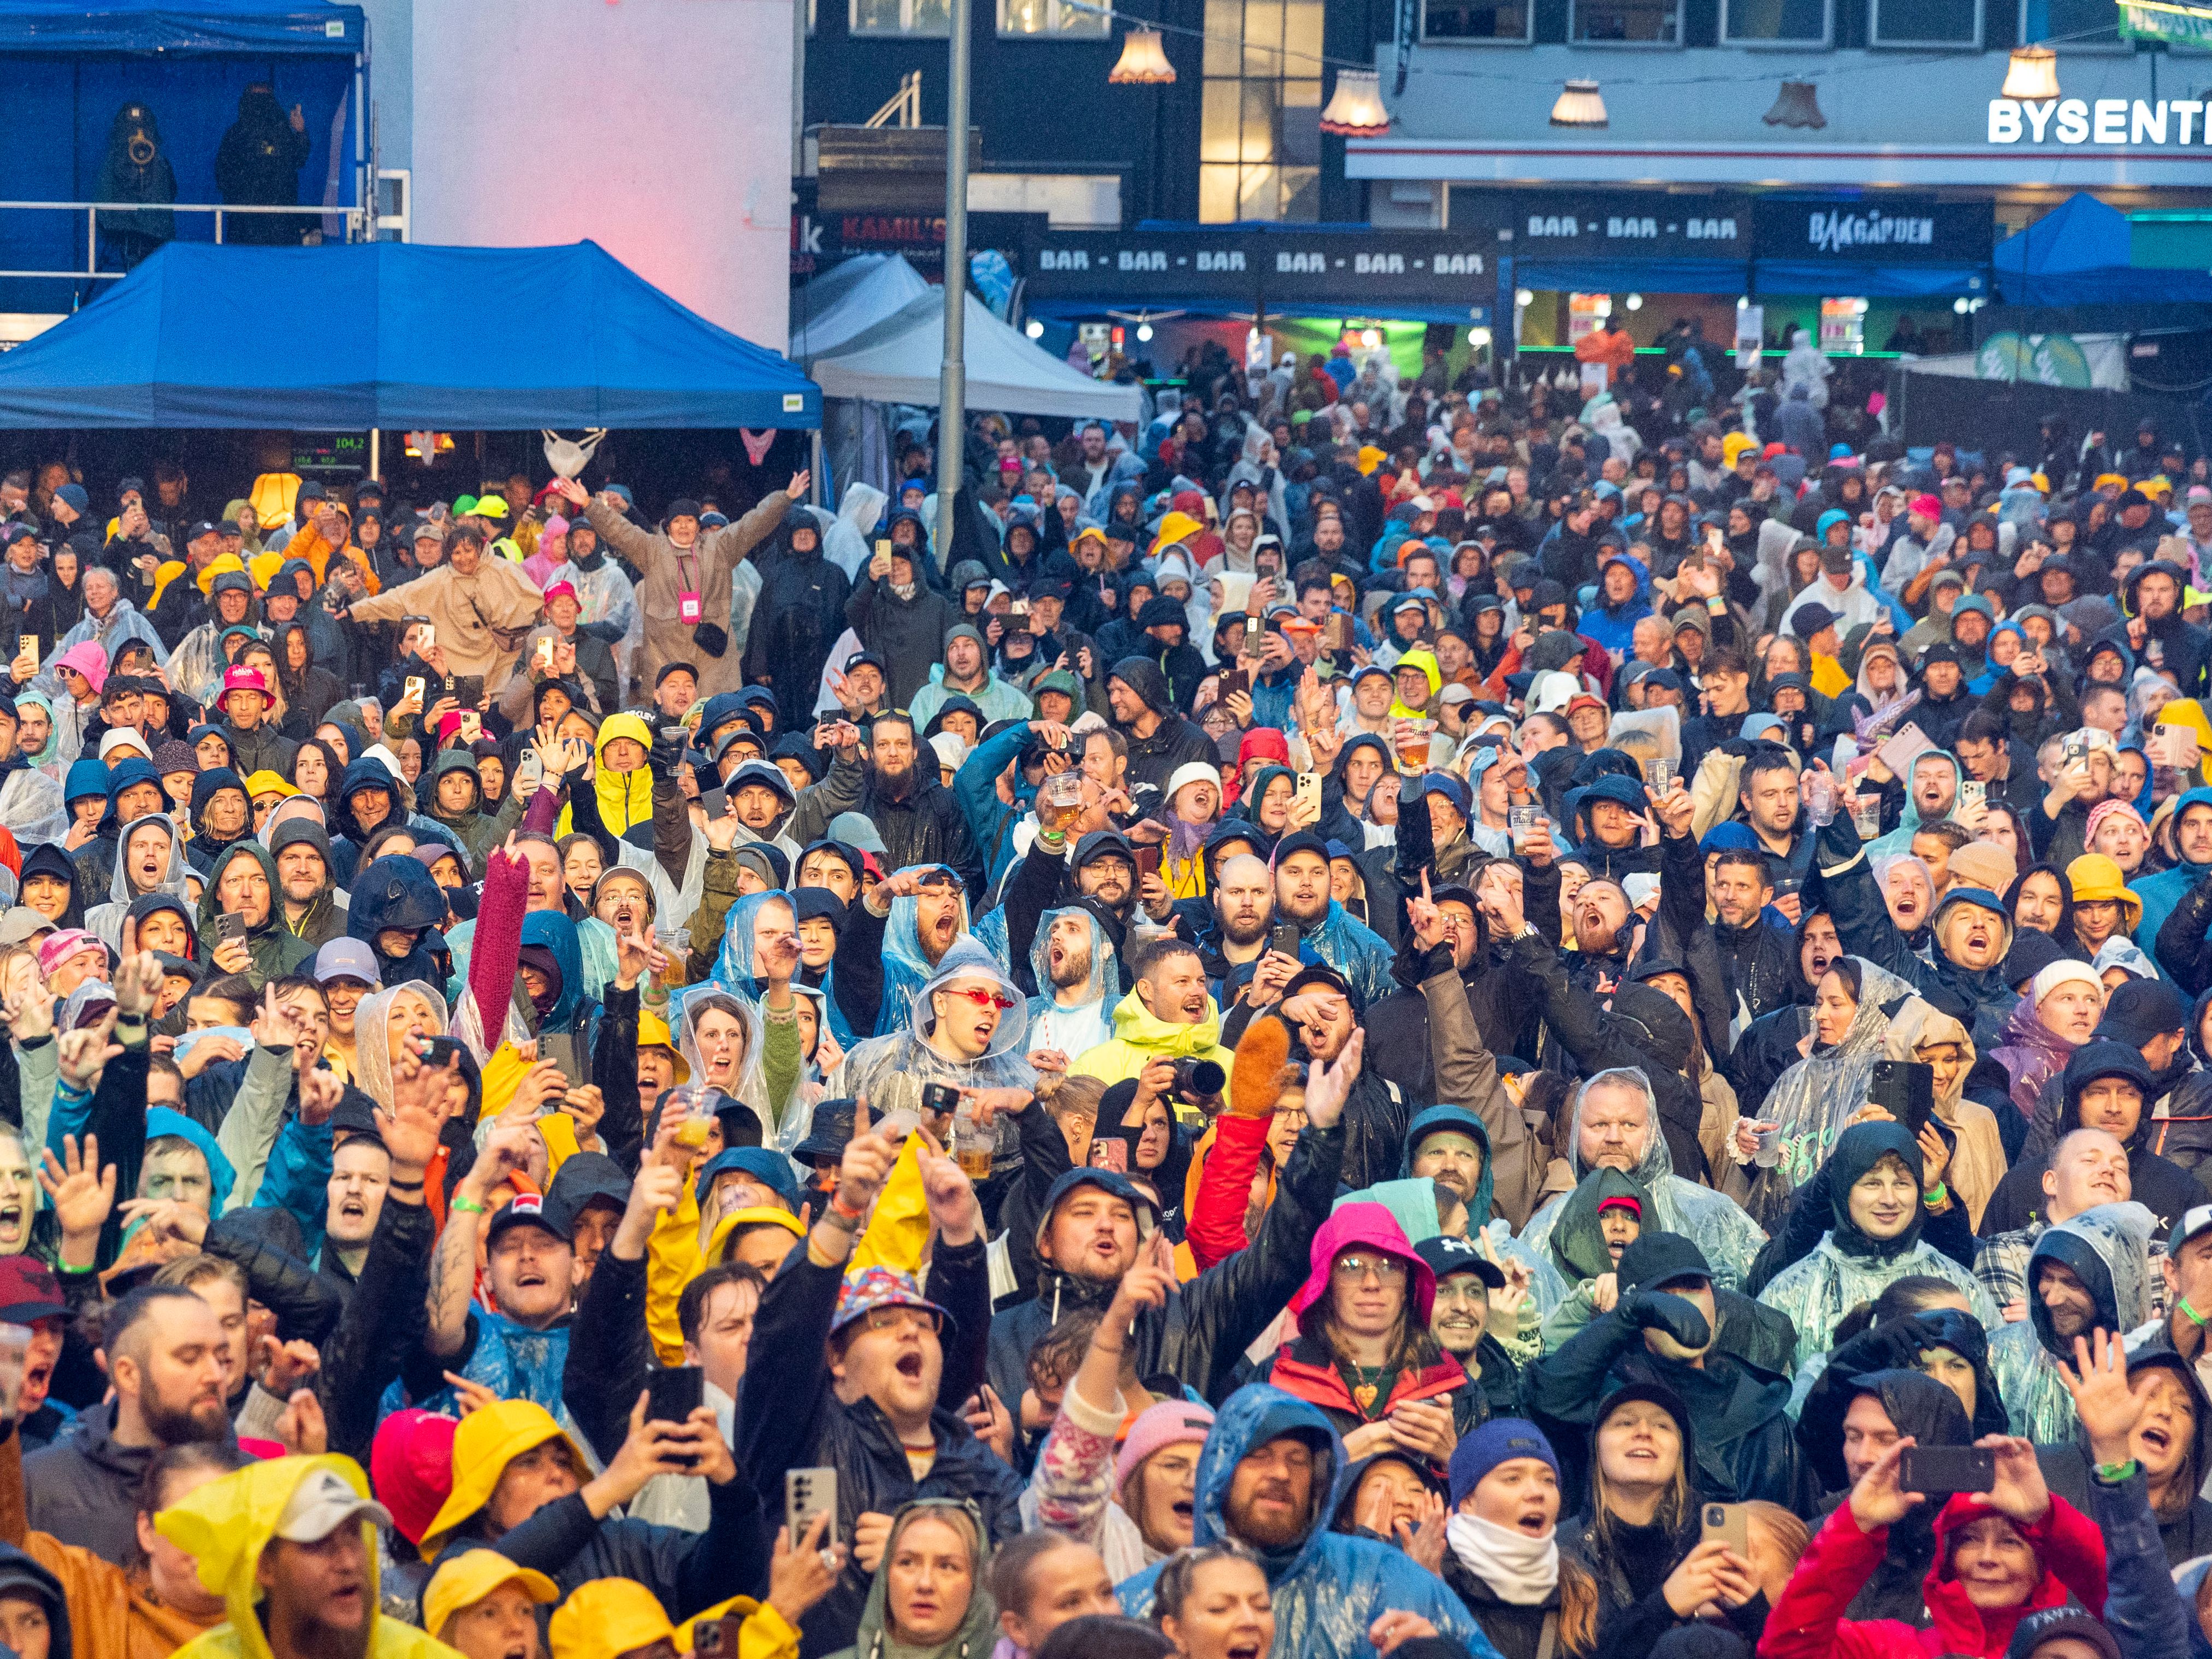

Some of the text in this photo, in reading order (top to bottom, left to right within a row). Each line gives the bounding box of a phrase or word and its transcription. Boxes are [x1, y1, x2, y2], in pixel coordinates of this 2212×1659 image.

[1988, 99, 2212, 145] BYSENT
[843, 217, 946, 241] KAMIL'S
[1528, 216, 1578, 237] BAR
[1607, 217, 1657, 238] BAR
[1686, 218, 1737, 239] BAR
[1040, 250, 1090, 270] BAR
[1119, 251, 1168, 271] BAR
[1196, 251, 1246, 271] BAR
[1276, 252, 1326, 272] BAR
[1355, 252, 1405, 273] BAR
[1434, 253, 1483, 274] BAR
